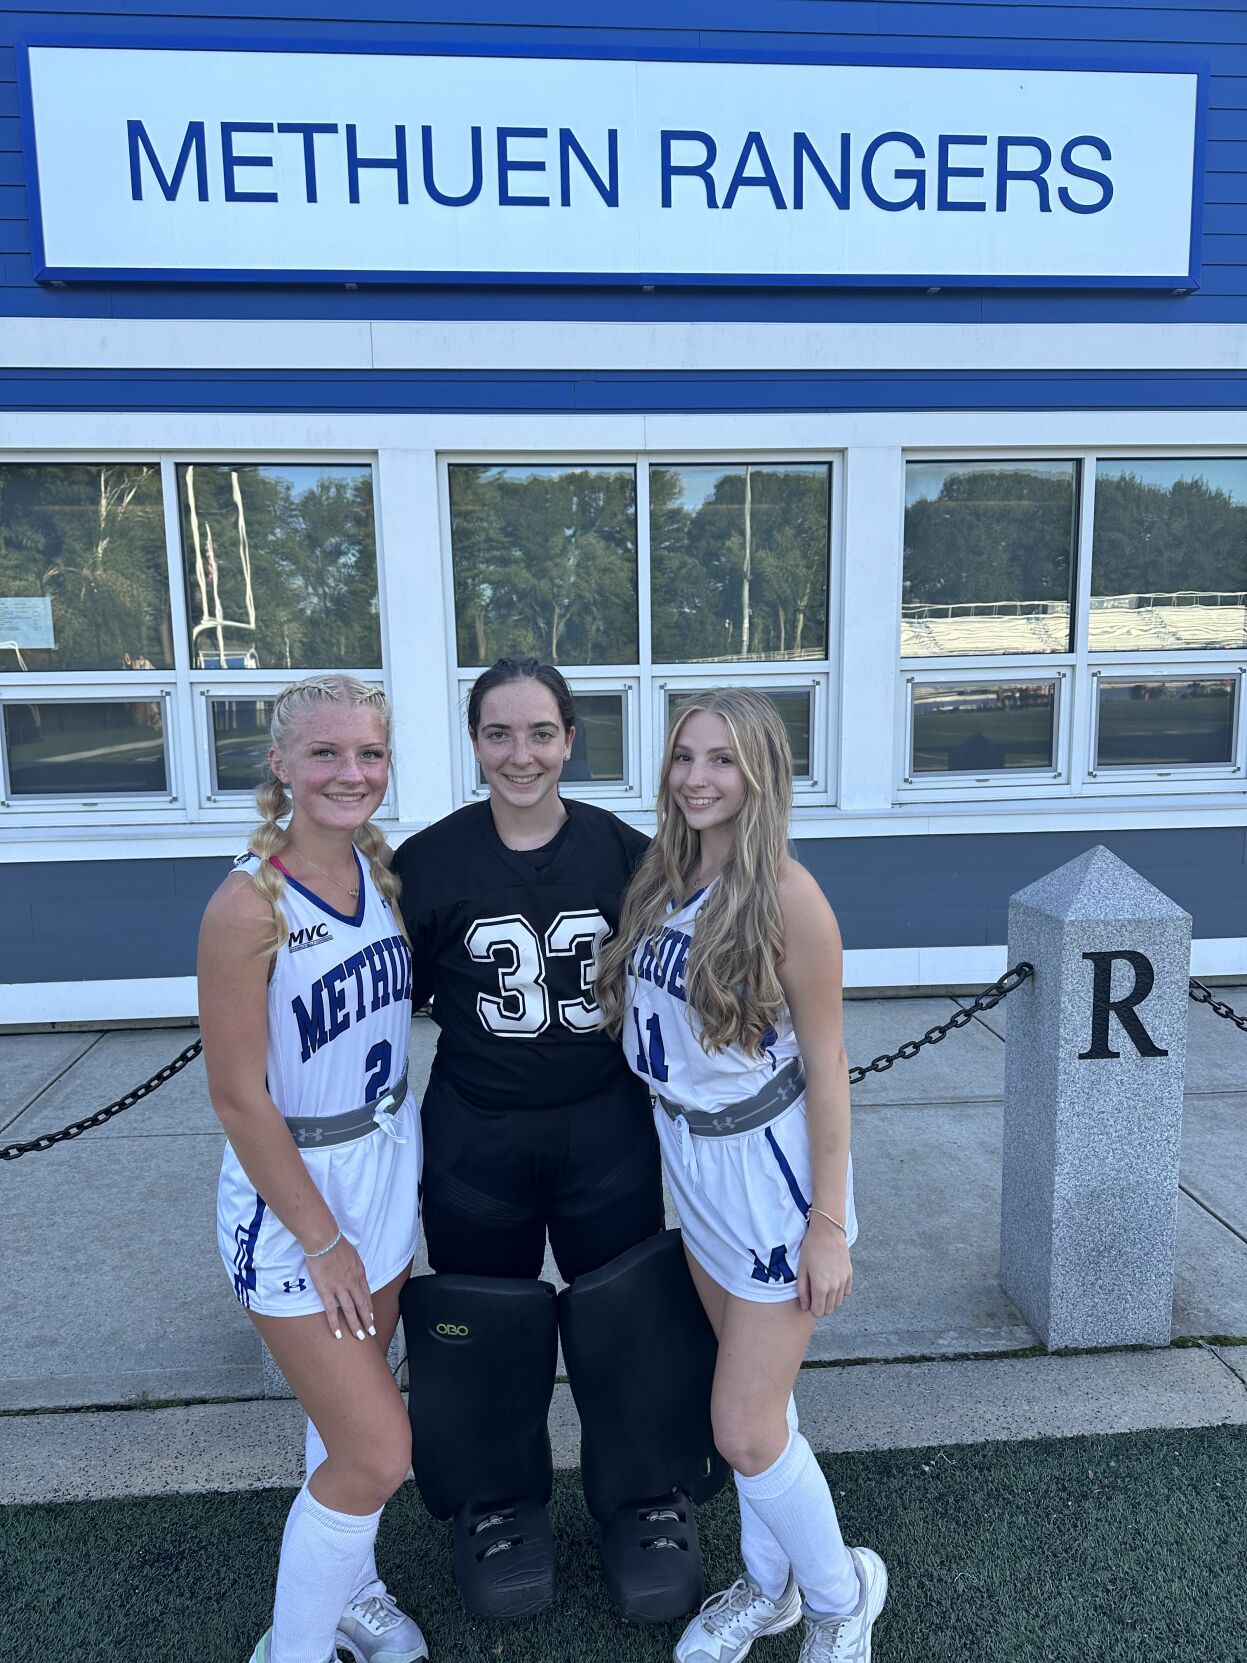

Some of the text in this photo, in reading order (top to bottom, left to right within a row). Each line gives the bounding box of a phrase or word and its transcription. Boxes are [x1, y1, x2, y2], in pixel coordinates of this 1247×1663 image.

[126, 119, 1114, 214] METHUEN RANGERS
[288, 922, 329, 948] MVC
[464, 908, 614, 1038] 33
[1078, 950, 1168, 1060] R
[365, 1038, 392, 1104] 2
[633, 1006, 668, 1083] 11
[436, 1323, 469, 1336] OBO
